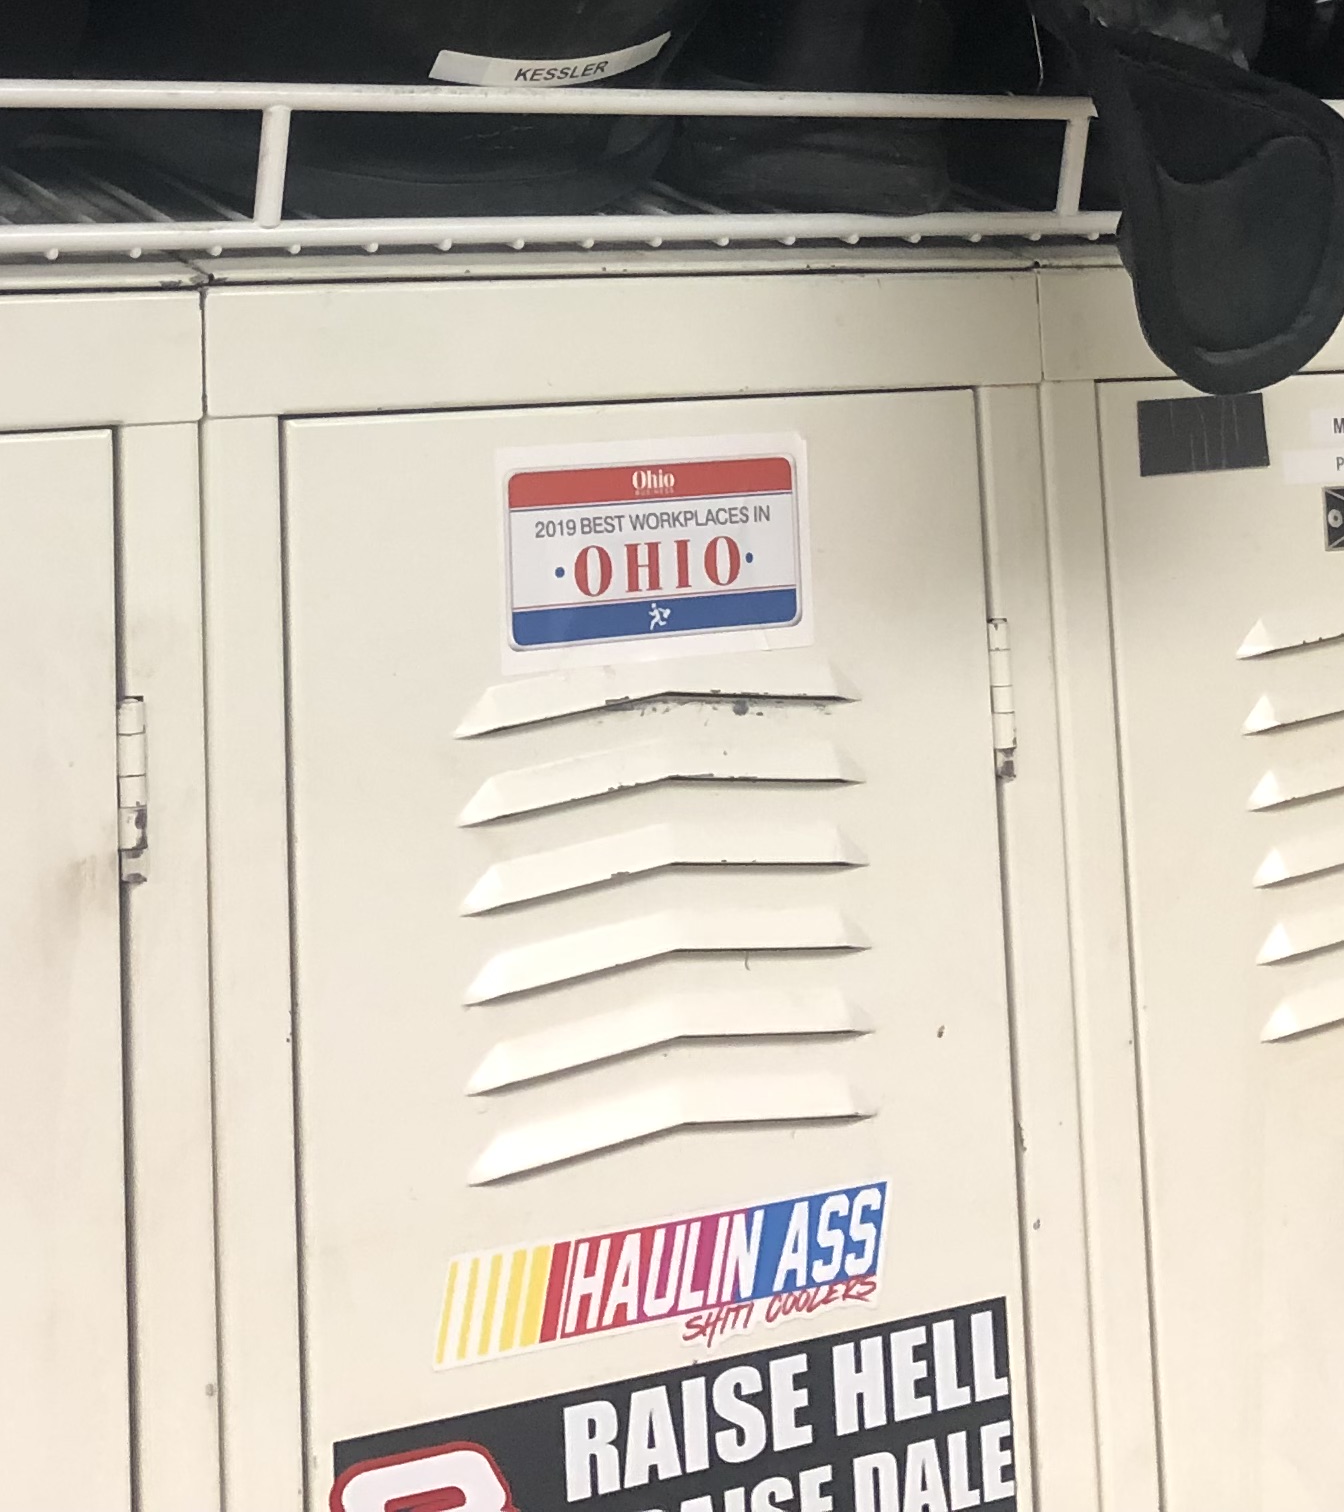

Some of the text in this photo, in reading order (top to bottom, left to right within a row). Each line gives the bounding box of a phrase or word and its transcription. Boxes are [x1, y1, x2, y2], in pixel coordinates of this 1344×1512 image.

[514, 61, 608, 82] KESSLER
[632, 468, 675, 490] Ohio
[535, 504, 771, 538] 2019 BEST WORKPLACES IN
[573, 535, 742, 598] OHIO
[564, 1186, 882, 1335] HAULIN ASS
[765, 1275, 877, 1323] COOLERS
[563, 1351, 813, 1503] RAISE
[831, 1309, 1009, 1437] HELL
[853, 1419, 1016, 1512] DALE
